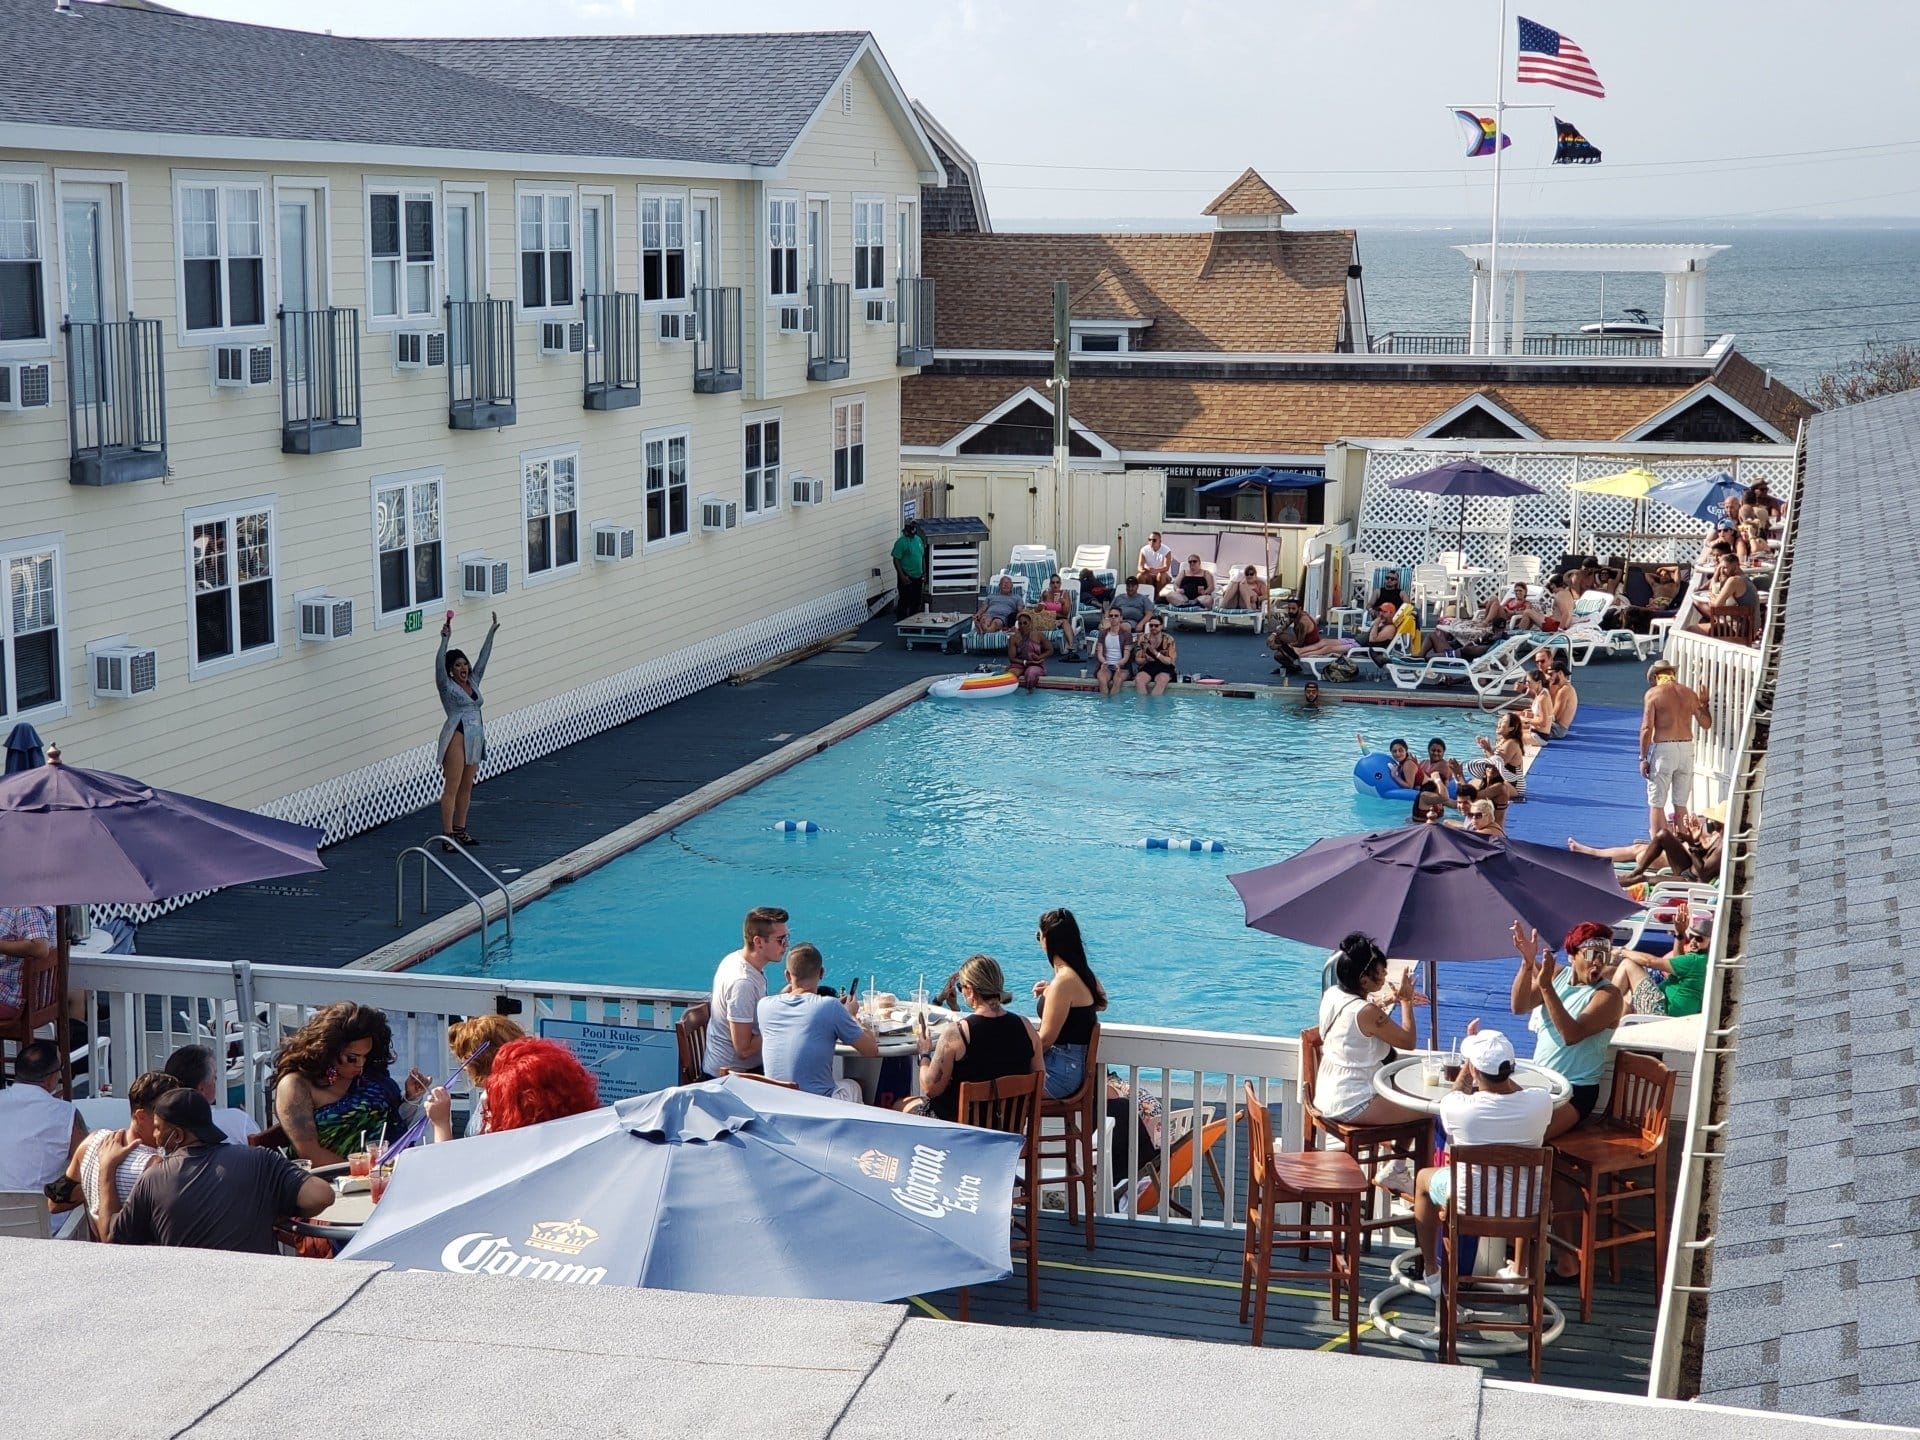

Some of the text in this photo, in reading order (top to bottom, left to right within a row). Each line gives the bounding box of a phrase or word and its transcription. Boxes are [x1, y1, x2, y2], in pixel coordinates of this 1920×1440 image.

[1165, 466, 1194, 477] CHERRY
[1196, 467, 1222, 477] GROVE
[408, 611, 421, 630] EXIT
[582, 1026, 641, 1043] Pool Rules
[890, 1143, 951, 1219] Corona
[943, 1174, 982, 1215] Extra
